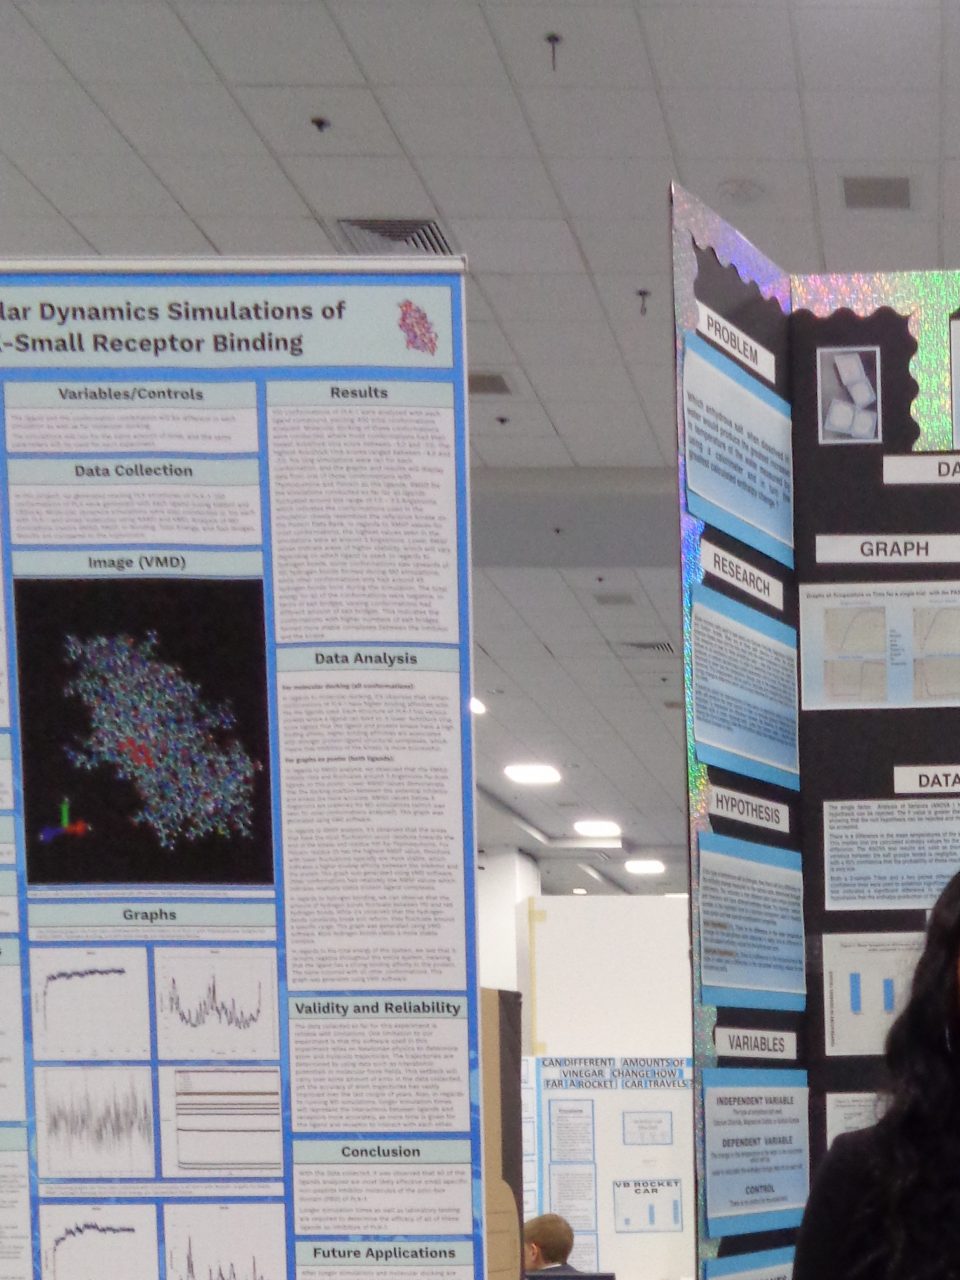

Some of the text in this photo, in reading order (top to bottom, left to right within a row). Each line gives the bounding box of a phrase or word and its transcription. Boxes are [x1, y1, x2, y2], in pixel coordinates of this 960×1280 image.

[40, 301, 159, 325] Dynamics
[168, 301, 314, 322] Simulations
[322, 301, 346, 321] of
[0, 333, 303, 356] -Small Receptor Binding
[707, 314, 759, 367] PROBLEM
[58, 387, 203, 402] Variables/Controls
[331, 386, 388, 399] Results
[75, 464, 193, 478] Data Collection
[860, 541, 929, 557] GRAPH
[88, 556, 186, 571] Image (VMD)
[713, 552, 770, 598] RESEARCH
[315, 652, 418, 668] Data Analysis
[716, 793, 780, 825] HYPOTHESIS
[123, 908, 176, 923] Graphs
[295, 1002, 461, 1017] Validity and Reliability
[729, 1035, 785, 1054] VARIABLES
[543, 1058, 684, 1067] CAN DIFFERENT AMOUNTS OF
[562, 1070, 676, 1078] VINEGAR CHANGE HOW
[546, 1080, 687, 1089] FAR A ROCKET CAR TRAVELS
[717, 1096, 794, 1106] INDEPENDENT VARIABLE
[722, 1136, 792, 1148] DEPENDENT VARIABLE
[341, 1146, 421, 1158] Conclusion
[746, 1184, 775, 1195] CONTROL
[313, 1247, 456, 1262] Future Applications
